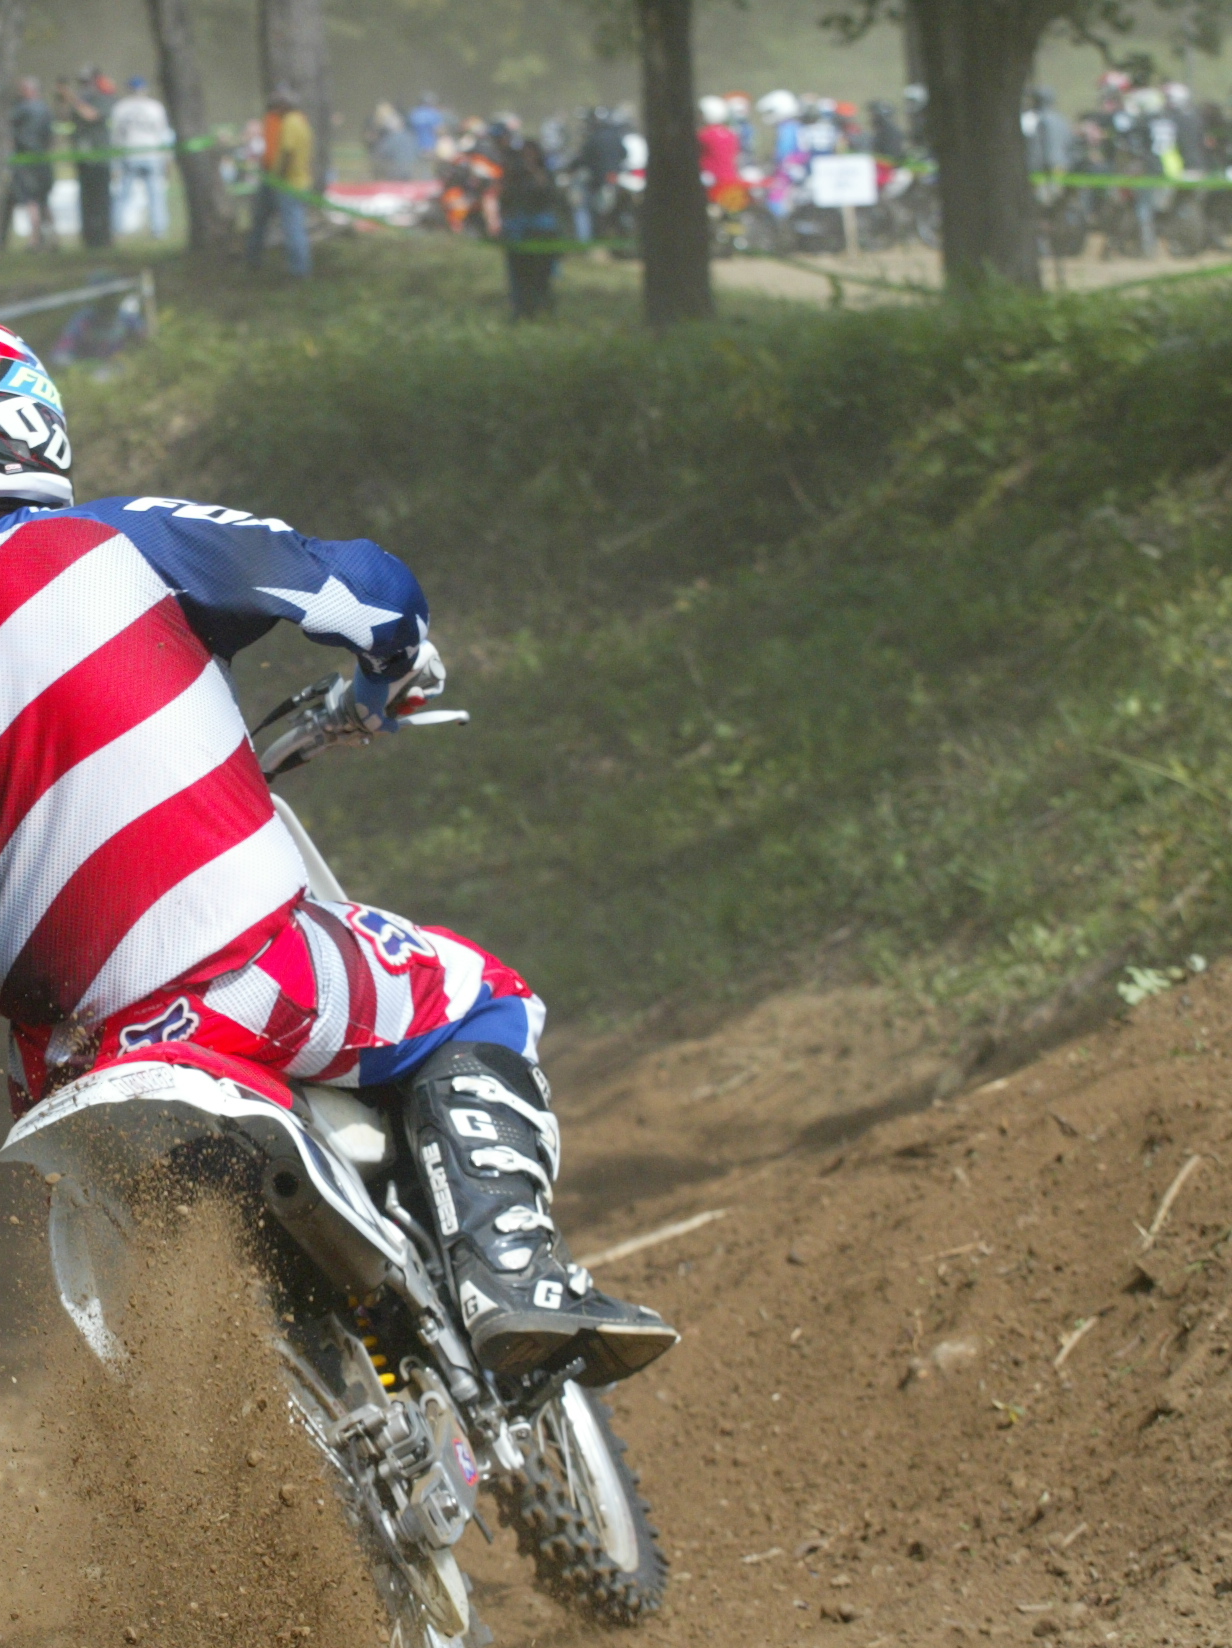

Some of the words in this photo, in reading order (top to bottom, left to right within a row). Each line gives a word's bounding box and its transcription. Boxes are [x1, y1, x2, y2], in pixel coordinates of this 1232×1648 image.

[450, 1109, 498, 1140] G
[463, 1294, 479, 1320] G
[533, 1280, 563, 1310] G
